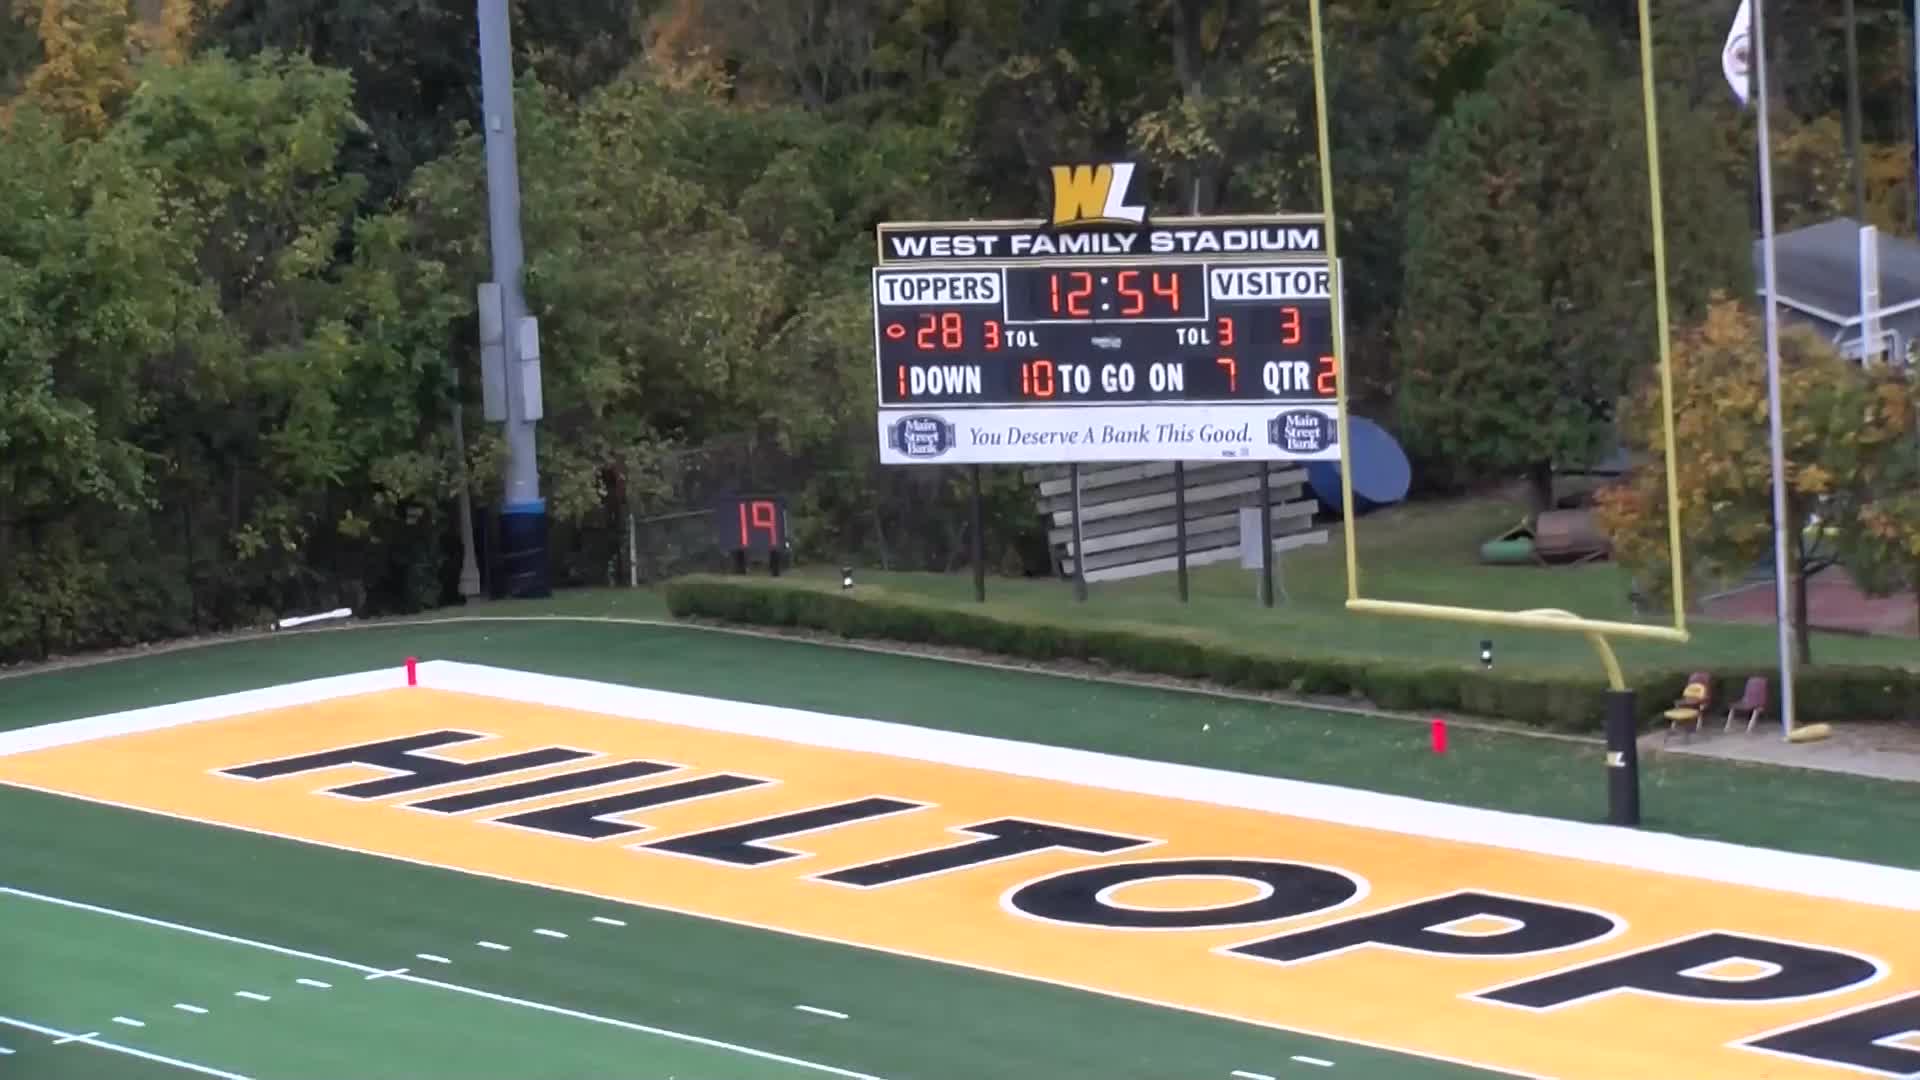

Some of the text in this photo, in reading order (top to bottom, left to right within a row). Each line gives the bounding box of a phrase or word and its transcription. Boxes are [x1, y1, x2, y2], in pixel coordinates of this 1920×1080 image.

[1051, 163, 1145, 225] WL
[892, 229, 1319, 256] WEST FAMILY STADIUM
[884, 277, 994, 300] TOPPERS
[1051, 270, 1179, 315] 12:54
[1216, 271, 1329, 295] VISITOR
[917, 313, 962, 348] 28
[984, 320, 999, 348] 3
[1005, 331, 1038, 347] TOL
[1176, 328, 1210, 344] TOL
[1218, 318, 1233, 345] 3
[1281, 307, 1300, 344] 3
[898, 366, 905, 395] 1
[910, 366, 981, 394] DOWN
[1022, 360, 1053, 396] 10
[1058, 362, 1184, 393] TO GO ON
[1217, 358, 1235, 392] 7
[1263, 361, 1310, 394] QTR
[1317, 357, 1337, 393] 2
[970, 422, 1252, 445] You Deserve A Bank This Good.
[1285, 426, 1320, 438] Street
[1286, 415, 1319, 426] Main
[1288, 438, 1319, 449] Bank
[740, 501, 776, 548] 19
